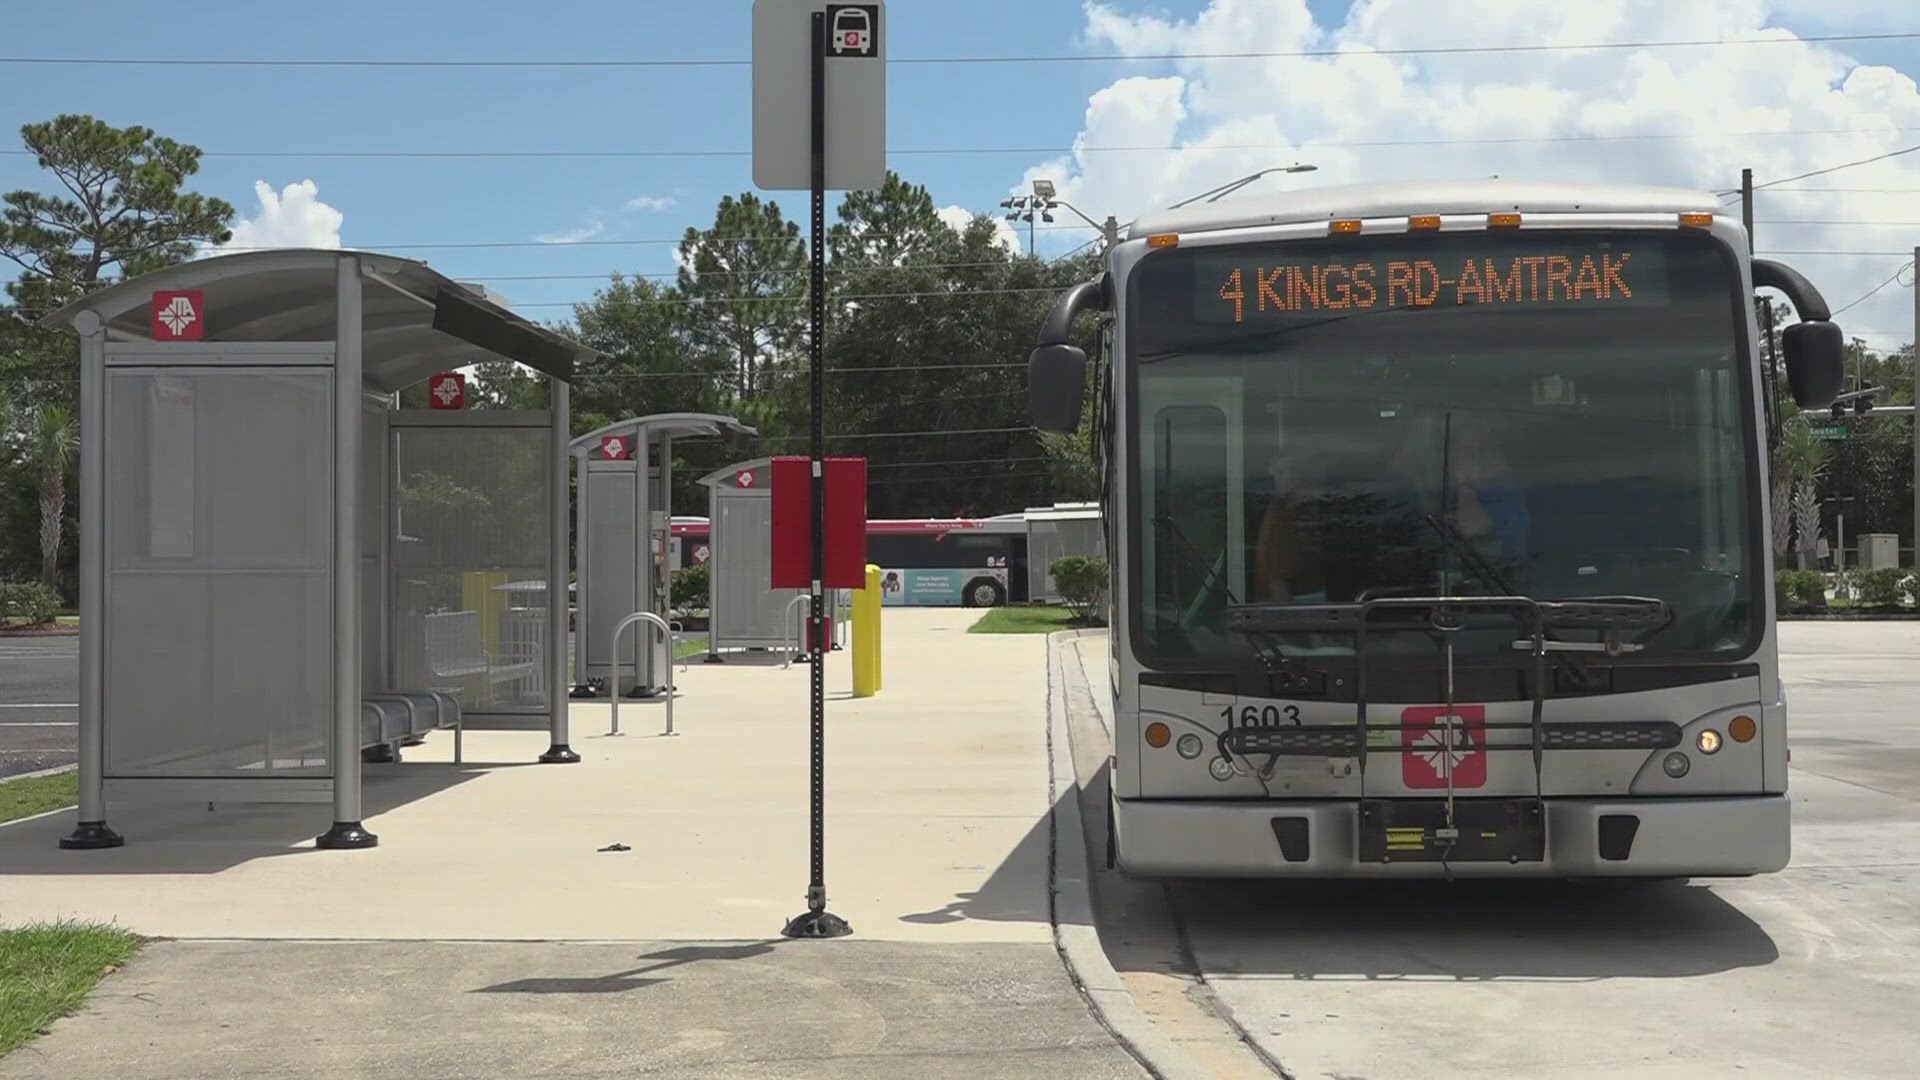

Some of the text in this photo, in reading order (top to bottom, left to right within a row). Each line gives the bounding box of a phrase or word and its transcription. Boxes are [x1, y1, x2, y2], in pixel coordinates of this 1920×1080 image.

[1219, 268, 1243, 322] 4
[1257, 263, 1377, 311] KINGS
[1221, 705, 1302, 728] 1603
